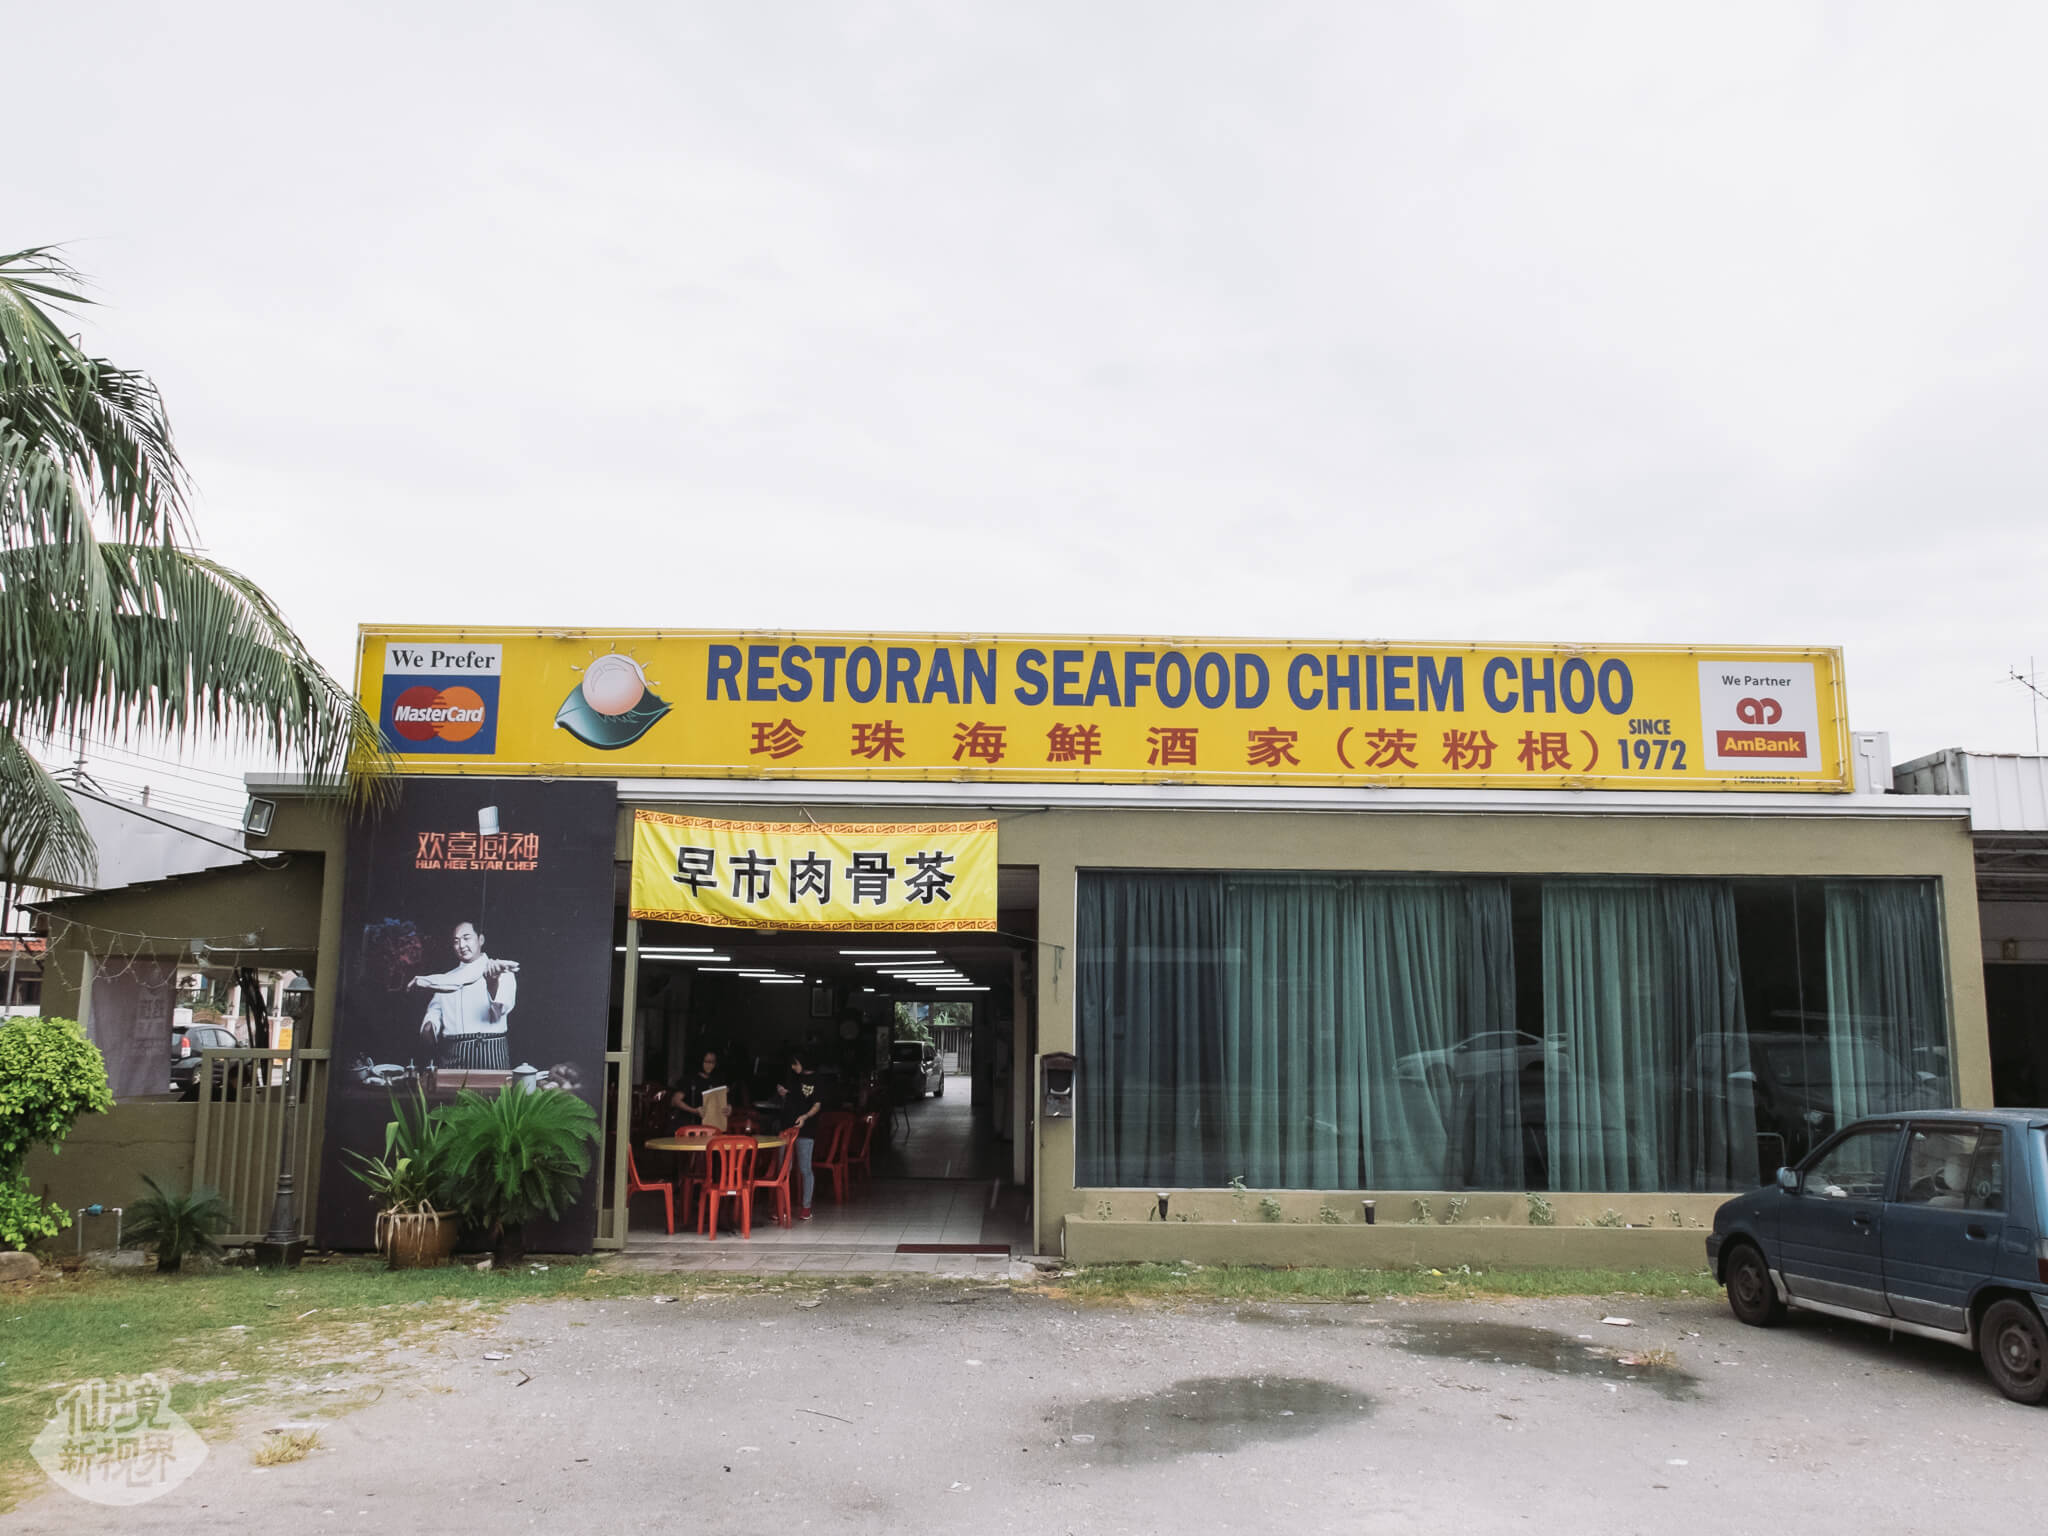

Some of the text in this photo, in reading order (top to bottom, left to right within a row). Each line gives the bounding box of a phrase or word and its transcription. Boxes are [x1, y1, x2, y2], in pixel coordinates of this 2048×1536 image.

[392, 650, 495, 669] We Prefer
[706, 644, 1634, 715] RESTORAN SEAFOOD CHIEM CHOO
[1722, 676, 1792, 687] We Partner
[394, 705, 484, 723] MasterCard
[1629, 719, 1671, 735] SINCE
[1724, 737, 1801, 752] AmBank
[1617, 739, 1687, 770] 1972
[416, 832, 539, 860] 欢喜厨神
[416, 860, 538, 871] HUA HEE STAR CHEF
[673, 846, 957, 905] 早市肉骨茶
